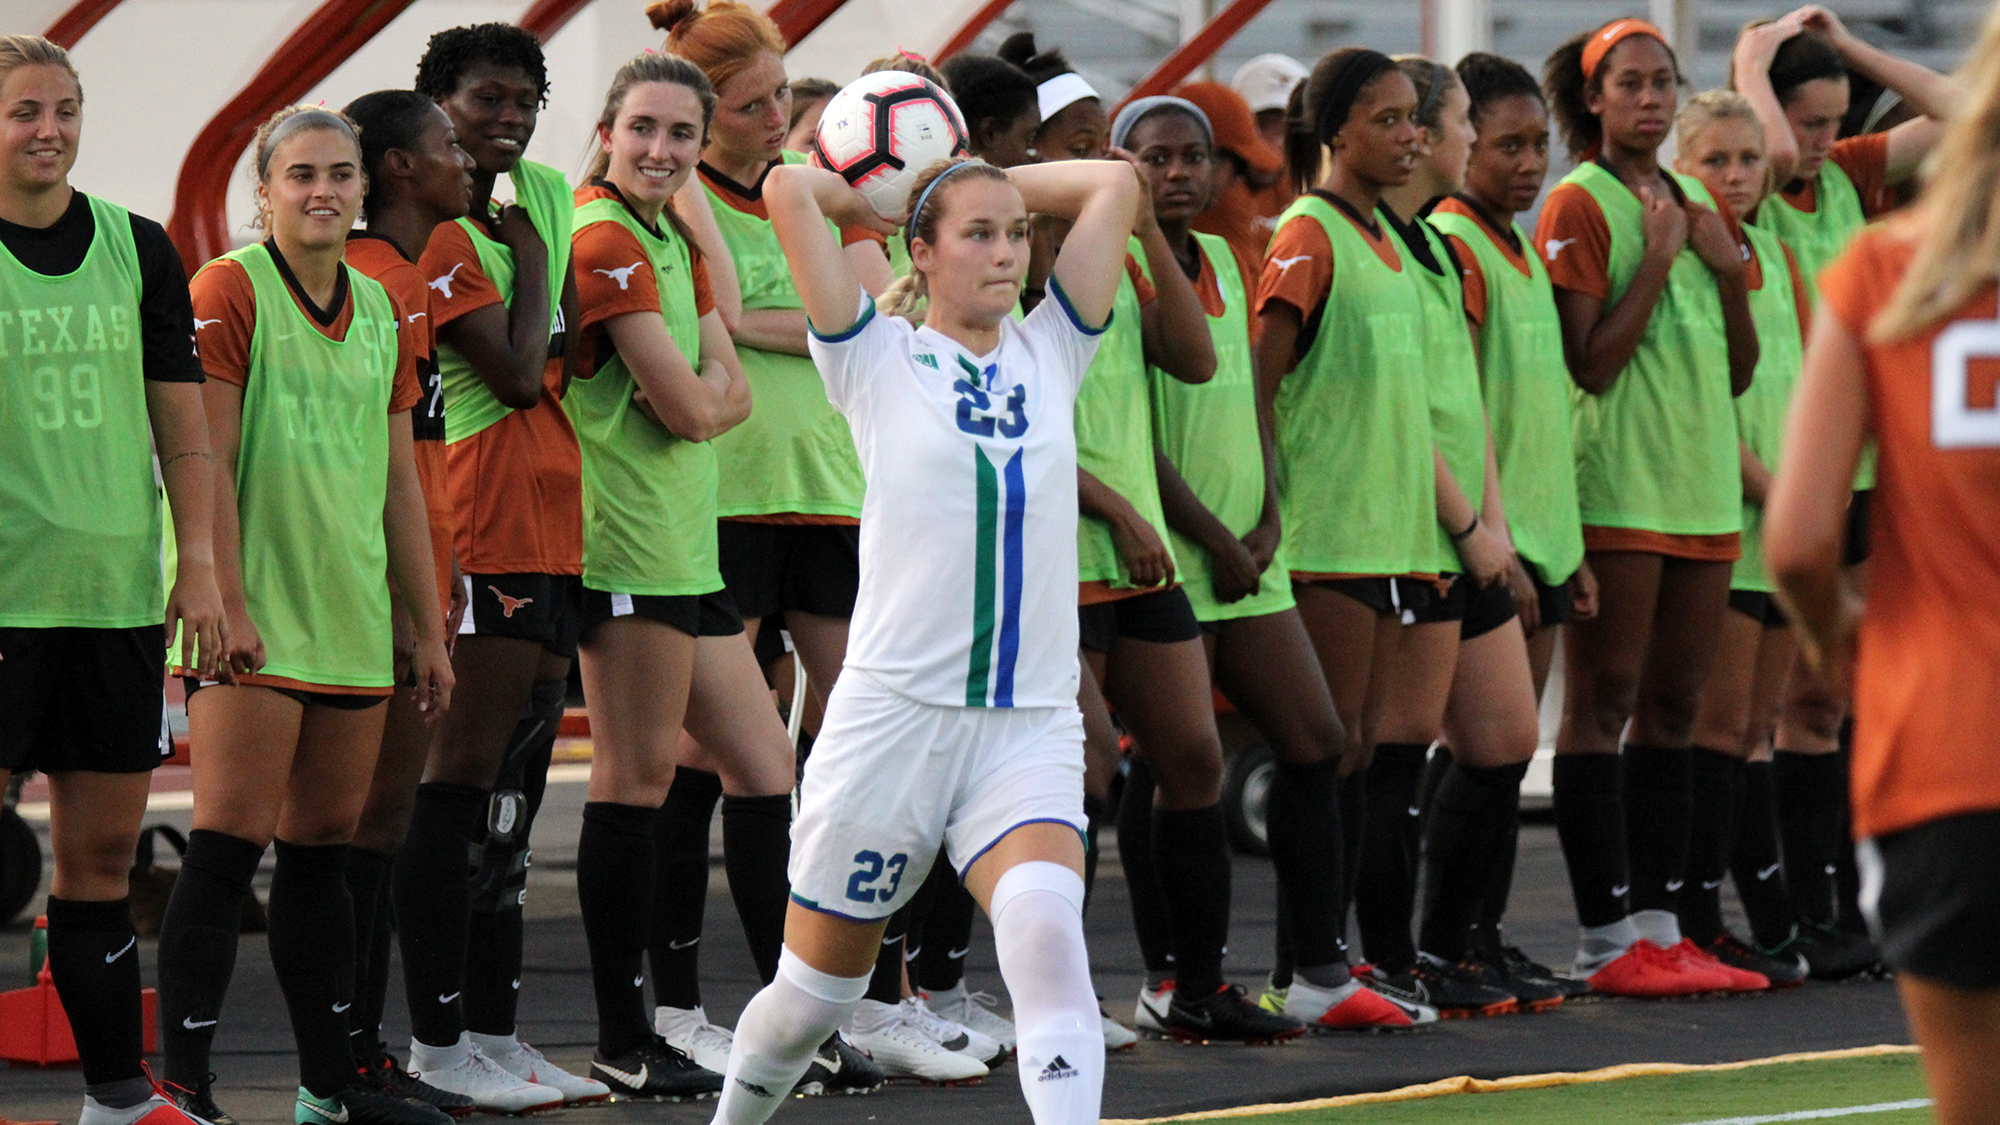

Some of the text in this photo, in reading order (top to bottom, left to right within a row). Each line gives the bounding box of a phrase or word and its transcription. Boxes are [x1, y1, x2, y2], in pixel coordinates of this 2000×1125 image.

[0, 304, 130, 357] TEXAS
[33, 364, 103, 430] 99
[953, 378, 1029, 439] 23
[845, 849, 909, 904] 23
[1038, 1069, 1079, 1082] adidas
